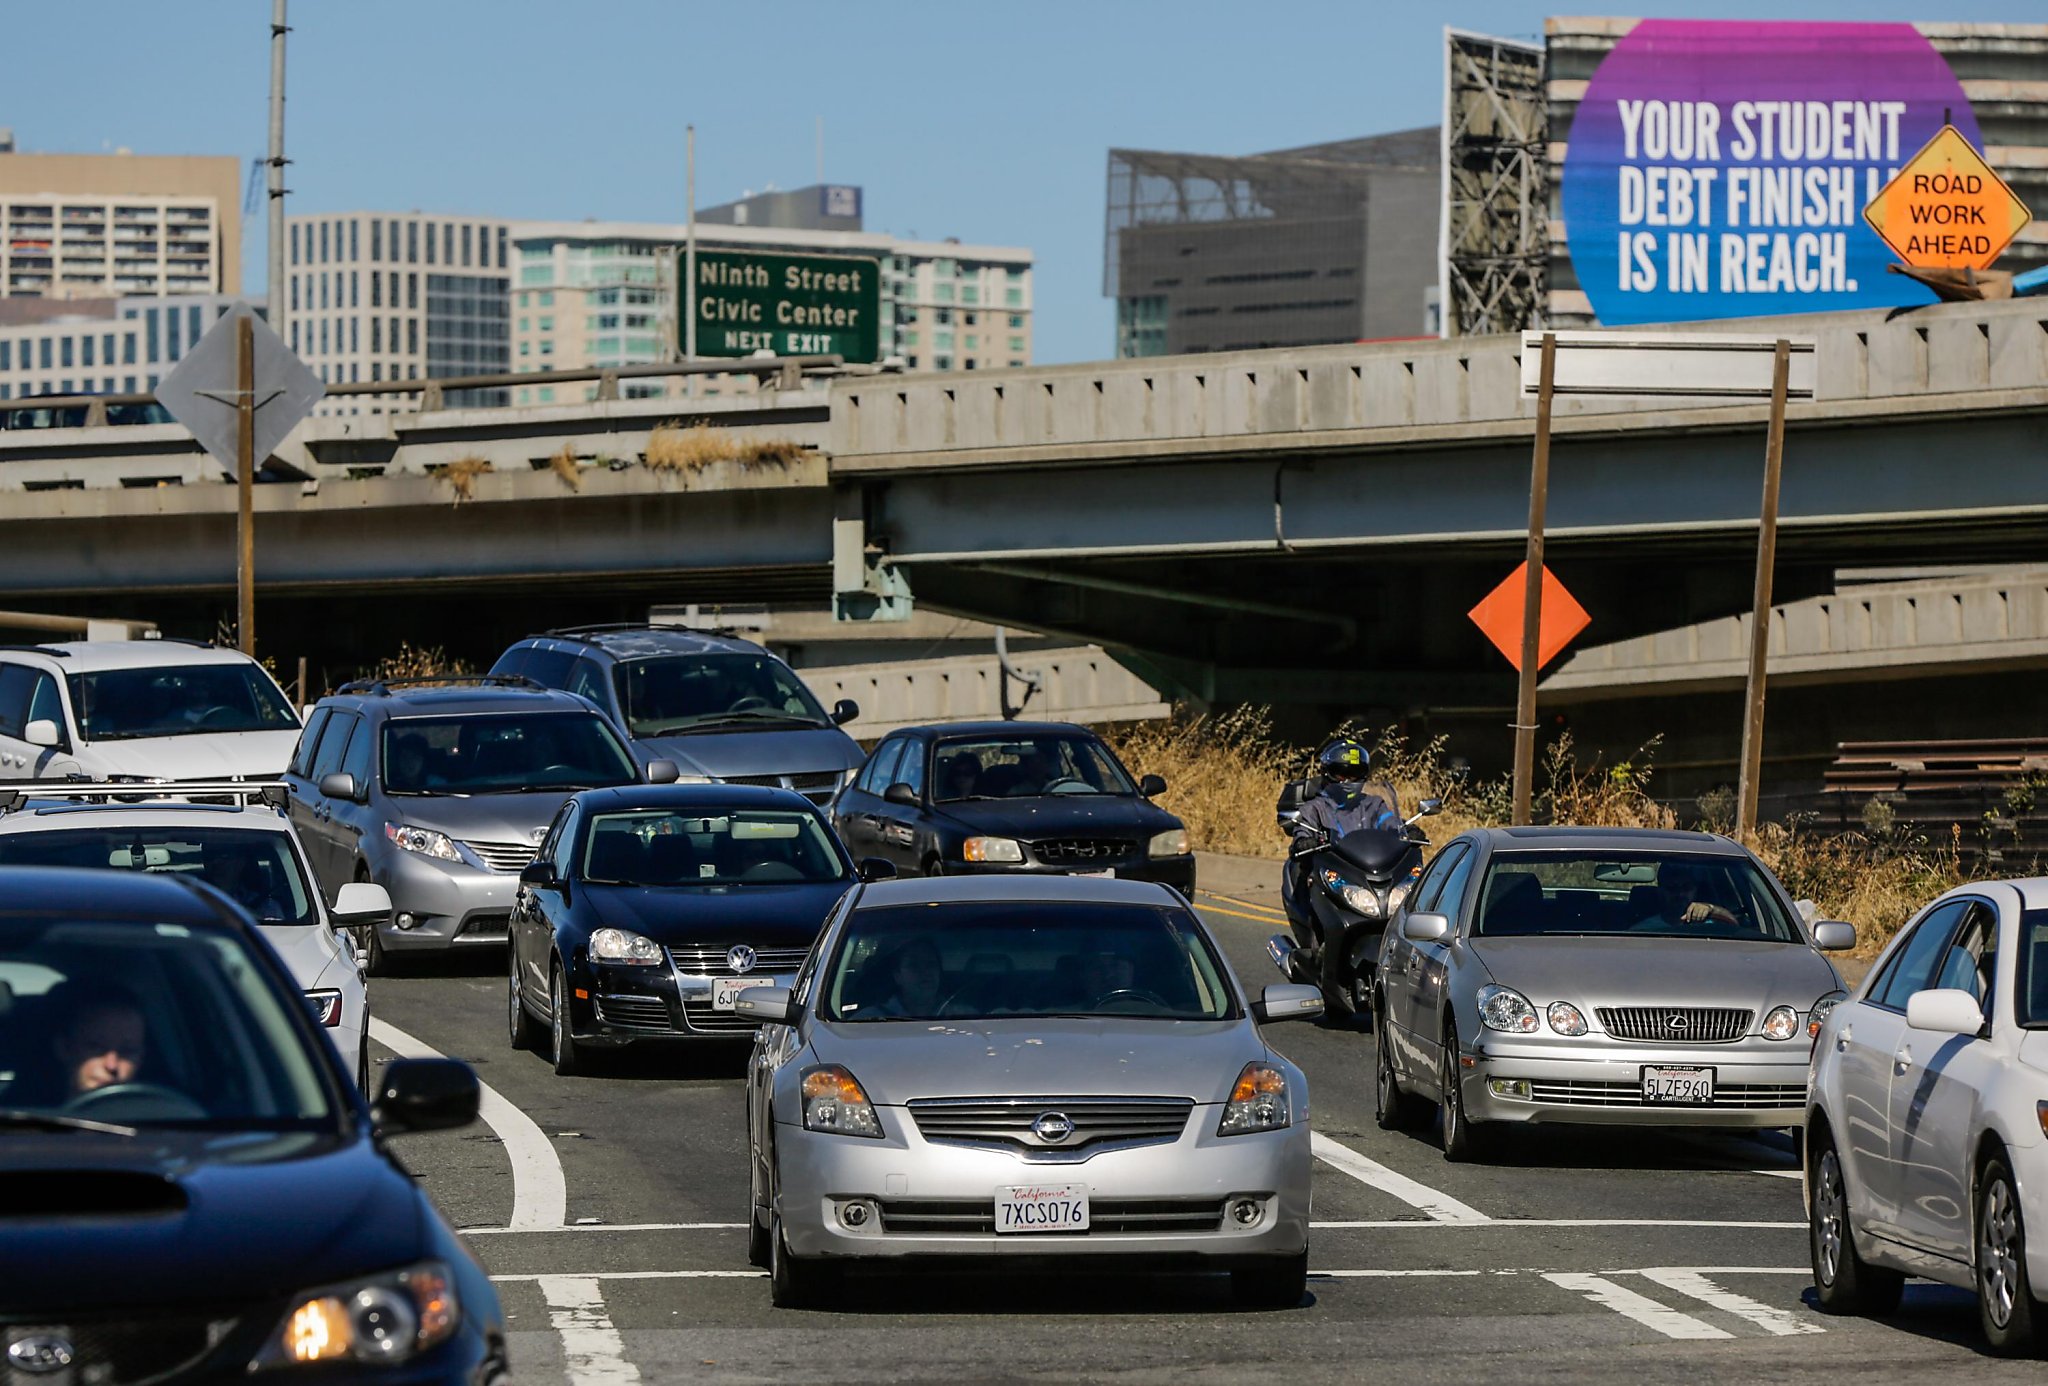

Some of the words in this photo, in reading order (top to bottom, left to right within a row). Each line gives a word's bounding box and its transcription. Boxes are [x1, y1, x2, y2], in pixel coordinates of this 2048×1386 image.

[1617, 99, 1721, 161] YOUR
[1730, 101, 1907, 161] STUDENT
[1914, 174, 1982, 194] ROAD
[1619, 166, 1718, 227] DEBT
[1727, 166, 1855, 227] FINISH
[1910, 204, 1986, 225] WORK
[1906, 235, 1991, 255] AHEAD
[1618, 231, 1658, 293] IS
[1668, 233, 1709, 293] IN
[1720, 233, 1858, 293] REACH.
[701, 262, 769, 287] Ninth
[785, 265, 861, 292] Street
[701, 297, 762, 322] Civic
[776, 300, 859, 327] Center
[725, 331, 773, 349] NEXT
[787, 333, 832, 353] EXIT
[1647, 1079, 1709, 1098] 5LZF960
[1014, 1188, 1071, 1201] California
[1002, 1201, 1082, 1224] 7XCS076
